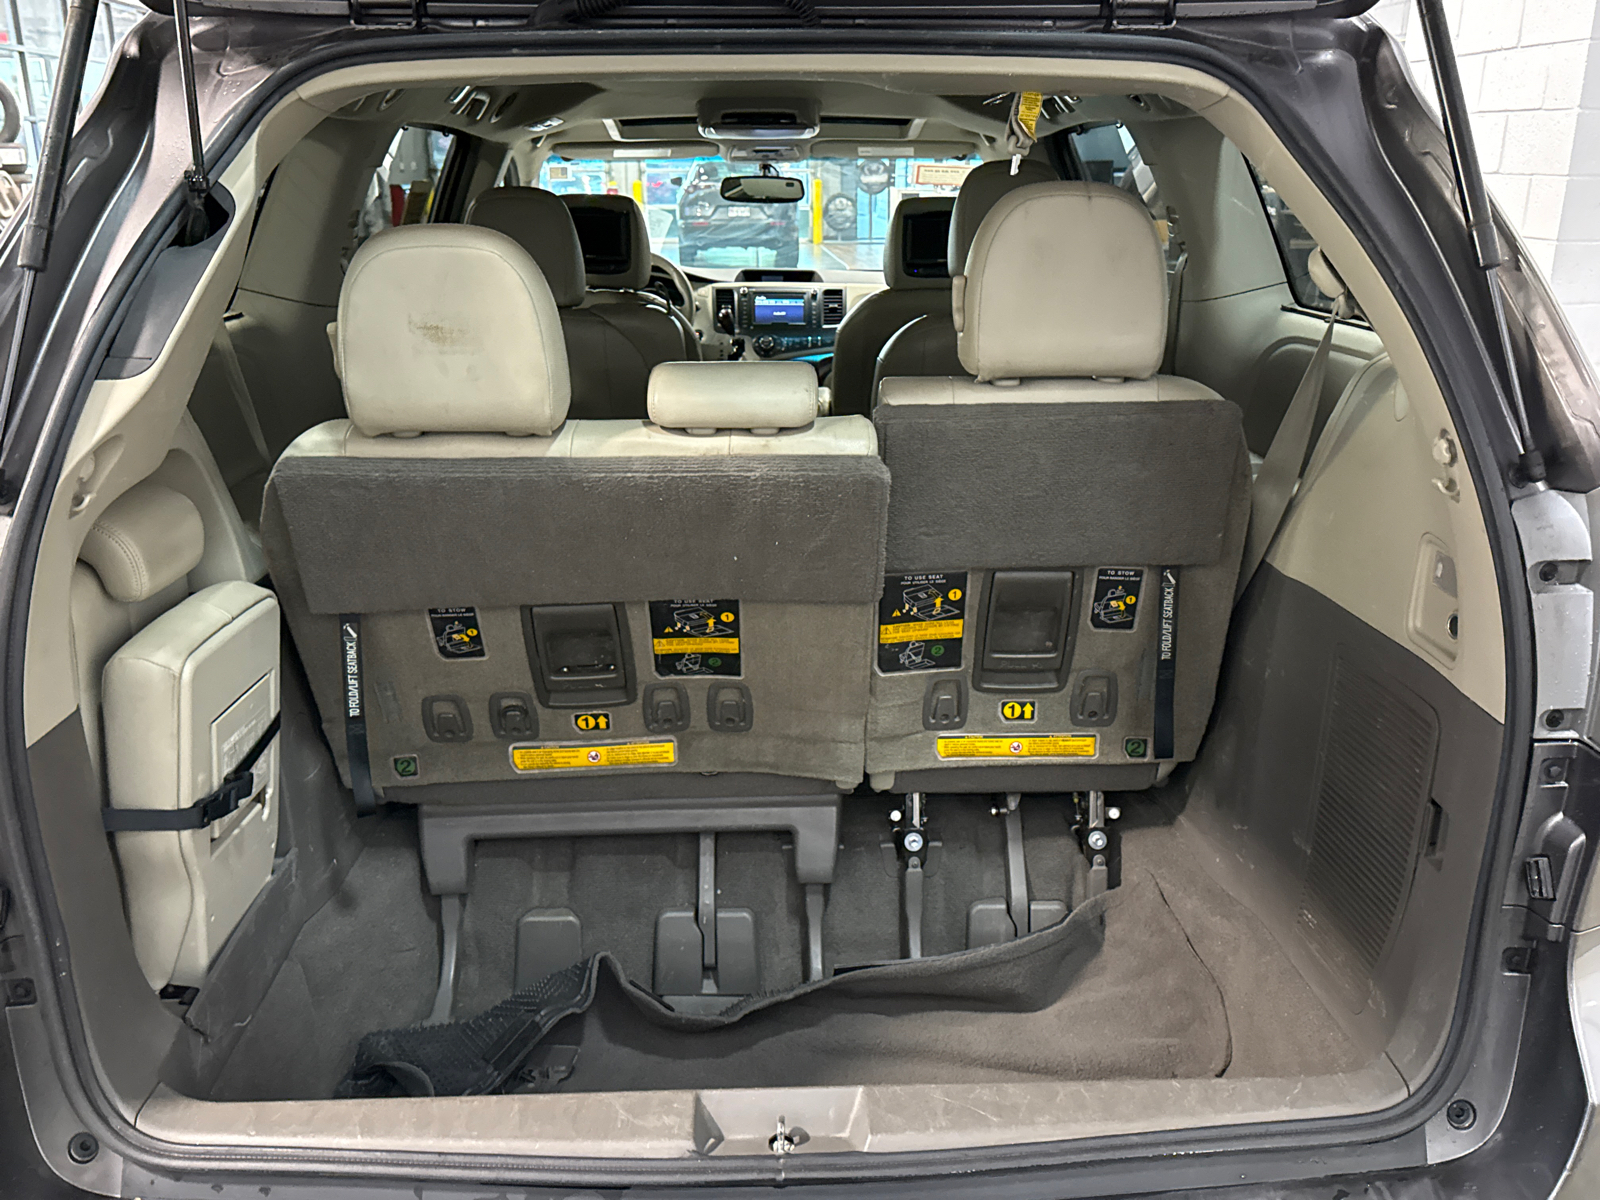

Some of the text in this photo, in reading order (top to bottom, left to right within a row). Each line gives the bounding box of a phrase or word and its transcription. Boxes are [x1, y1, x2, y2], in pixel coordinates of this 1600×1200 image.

[1161, 587, 1174, 660] TO FOLD/LIFT SEATBACK
[346, 641, 361, 718] TO FOLD/LIFT SEATBACK
